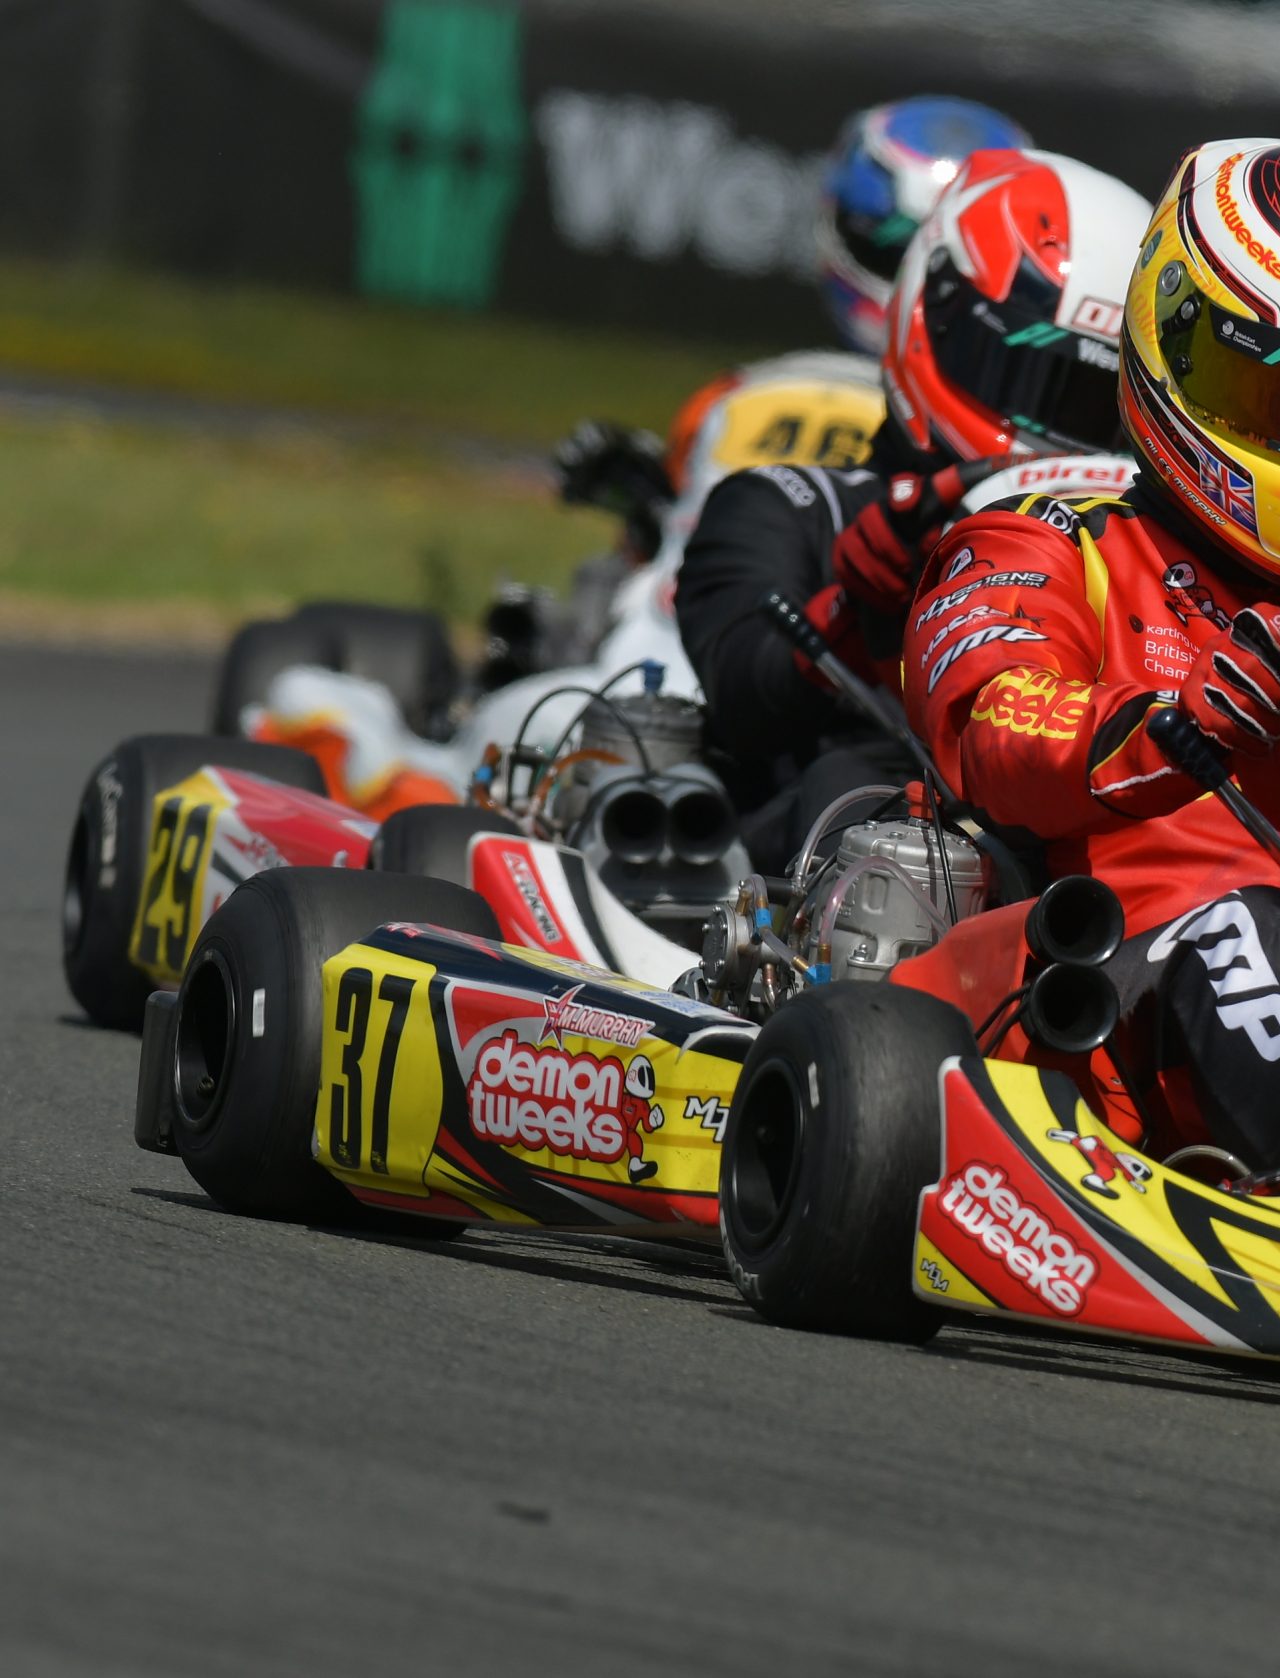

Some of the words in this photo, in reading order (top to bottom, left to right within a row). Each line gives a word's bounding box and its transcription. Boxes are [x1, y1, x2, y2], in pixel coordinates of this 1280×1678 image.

[1173, 476, 1226, 526] MURPHY
[1145, 640, 1196, 664] British
[136, 796, 211, 972] 29
[329, 967, 419, 1176] 37
[478, 1038, 621, 1108] demon
[470, 1087, 623, 1152] tweeks
[943, 1178, 1081, 1311] tweeks
[965, 1166, 1095, 1287] demon
